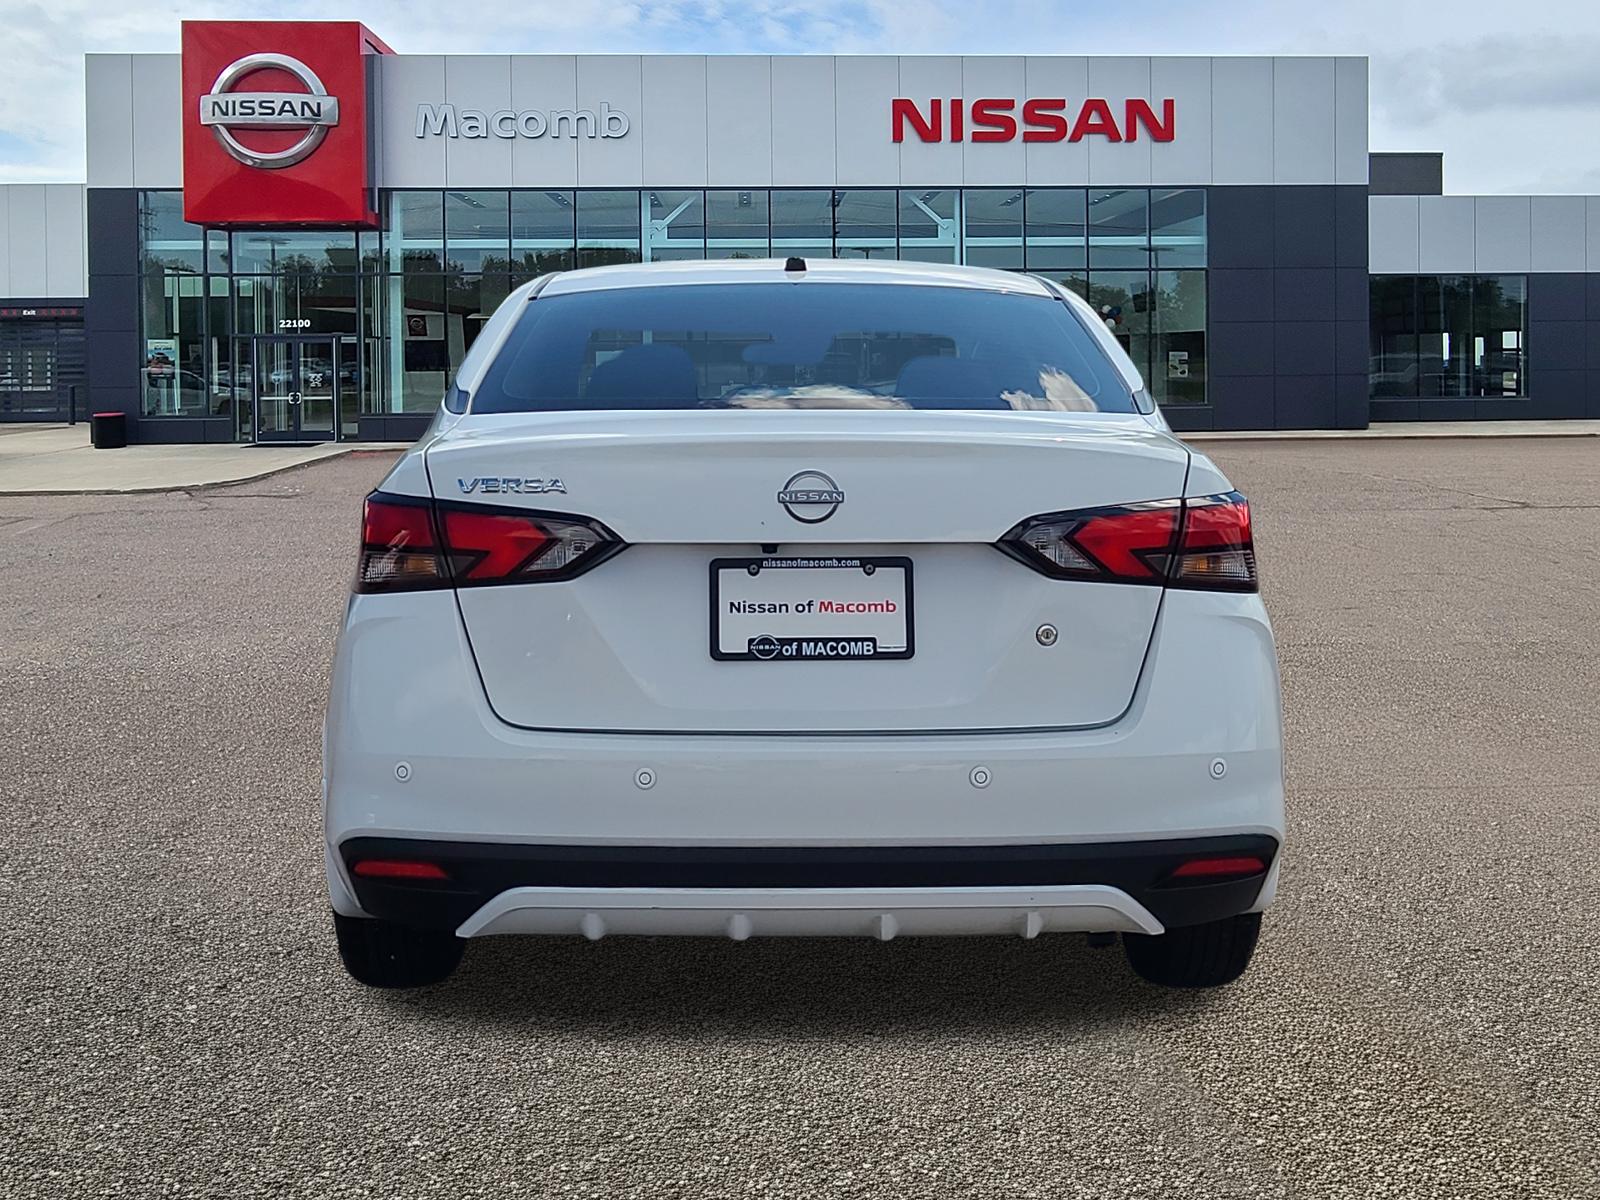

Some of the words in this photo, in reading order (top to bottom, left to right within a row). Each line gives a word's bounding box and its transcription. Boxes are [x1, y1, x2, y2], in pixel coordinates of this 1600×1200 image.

[211, 100, 322, 117] NISSAN
[415, 102, 630, 139] Macomb
[891, 98, 1176, 143] NISSAN
[279, 319, 311, 328] 22100
[457, 477, 568, 494] VERSA
[779, 492, 843, 501] NISSAN
[762, 558, 861, 568] nissanofmacomb.com
[729, 600, 790, 614] Nissan
[795, 600, 814, 614] of
[818, 600, 897, 614] Macomb
[782, 641, 798, 656] of
[801, 642, 874, 656] MACOMB
